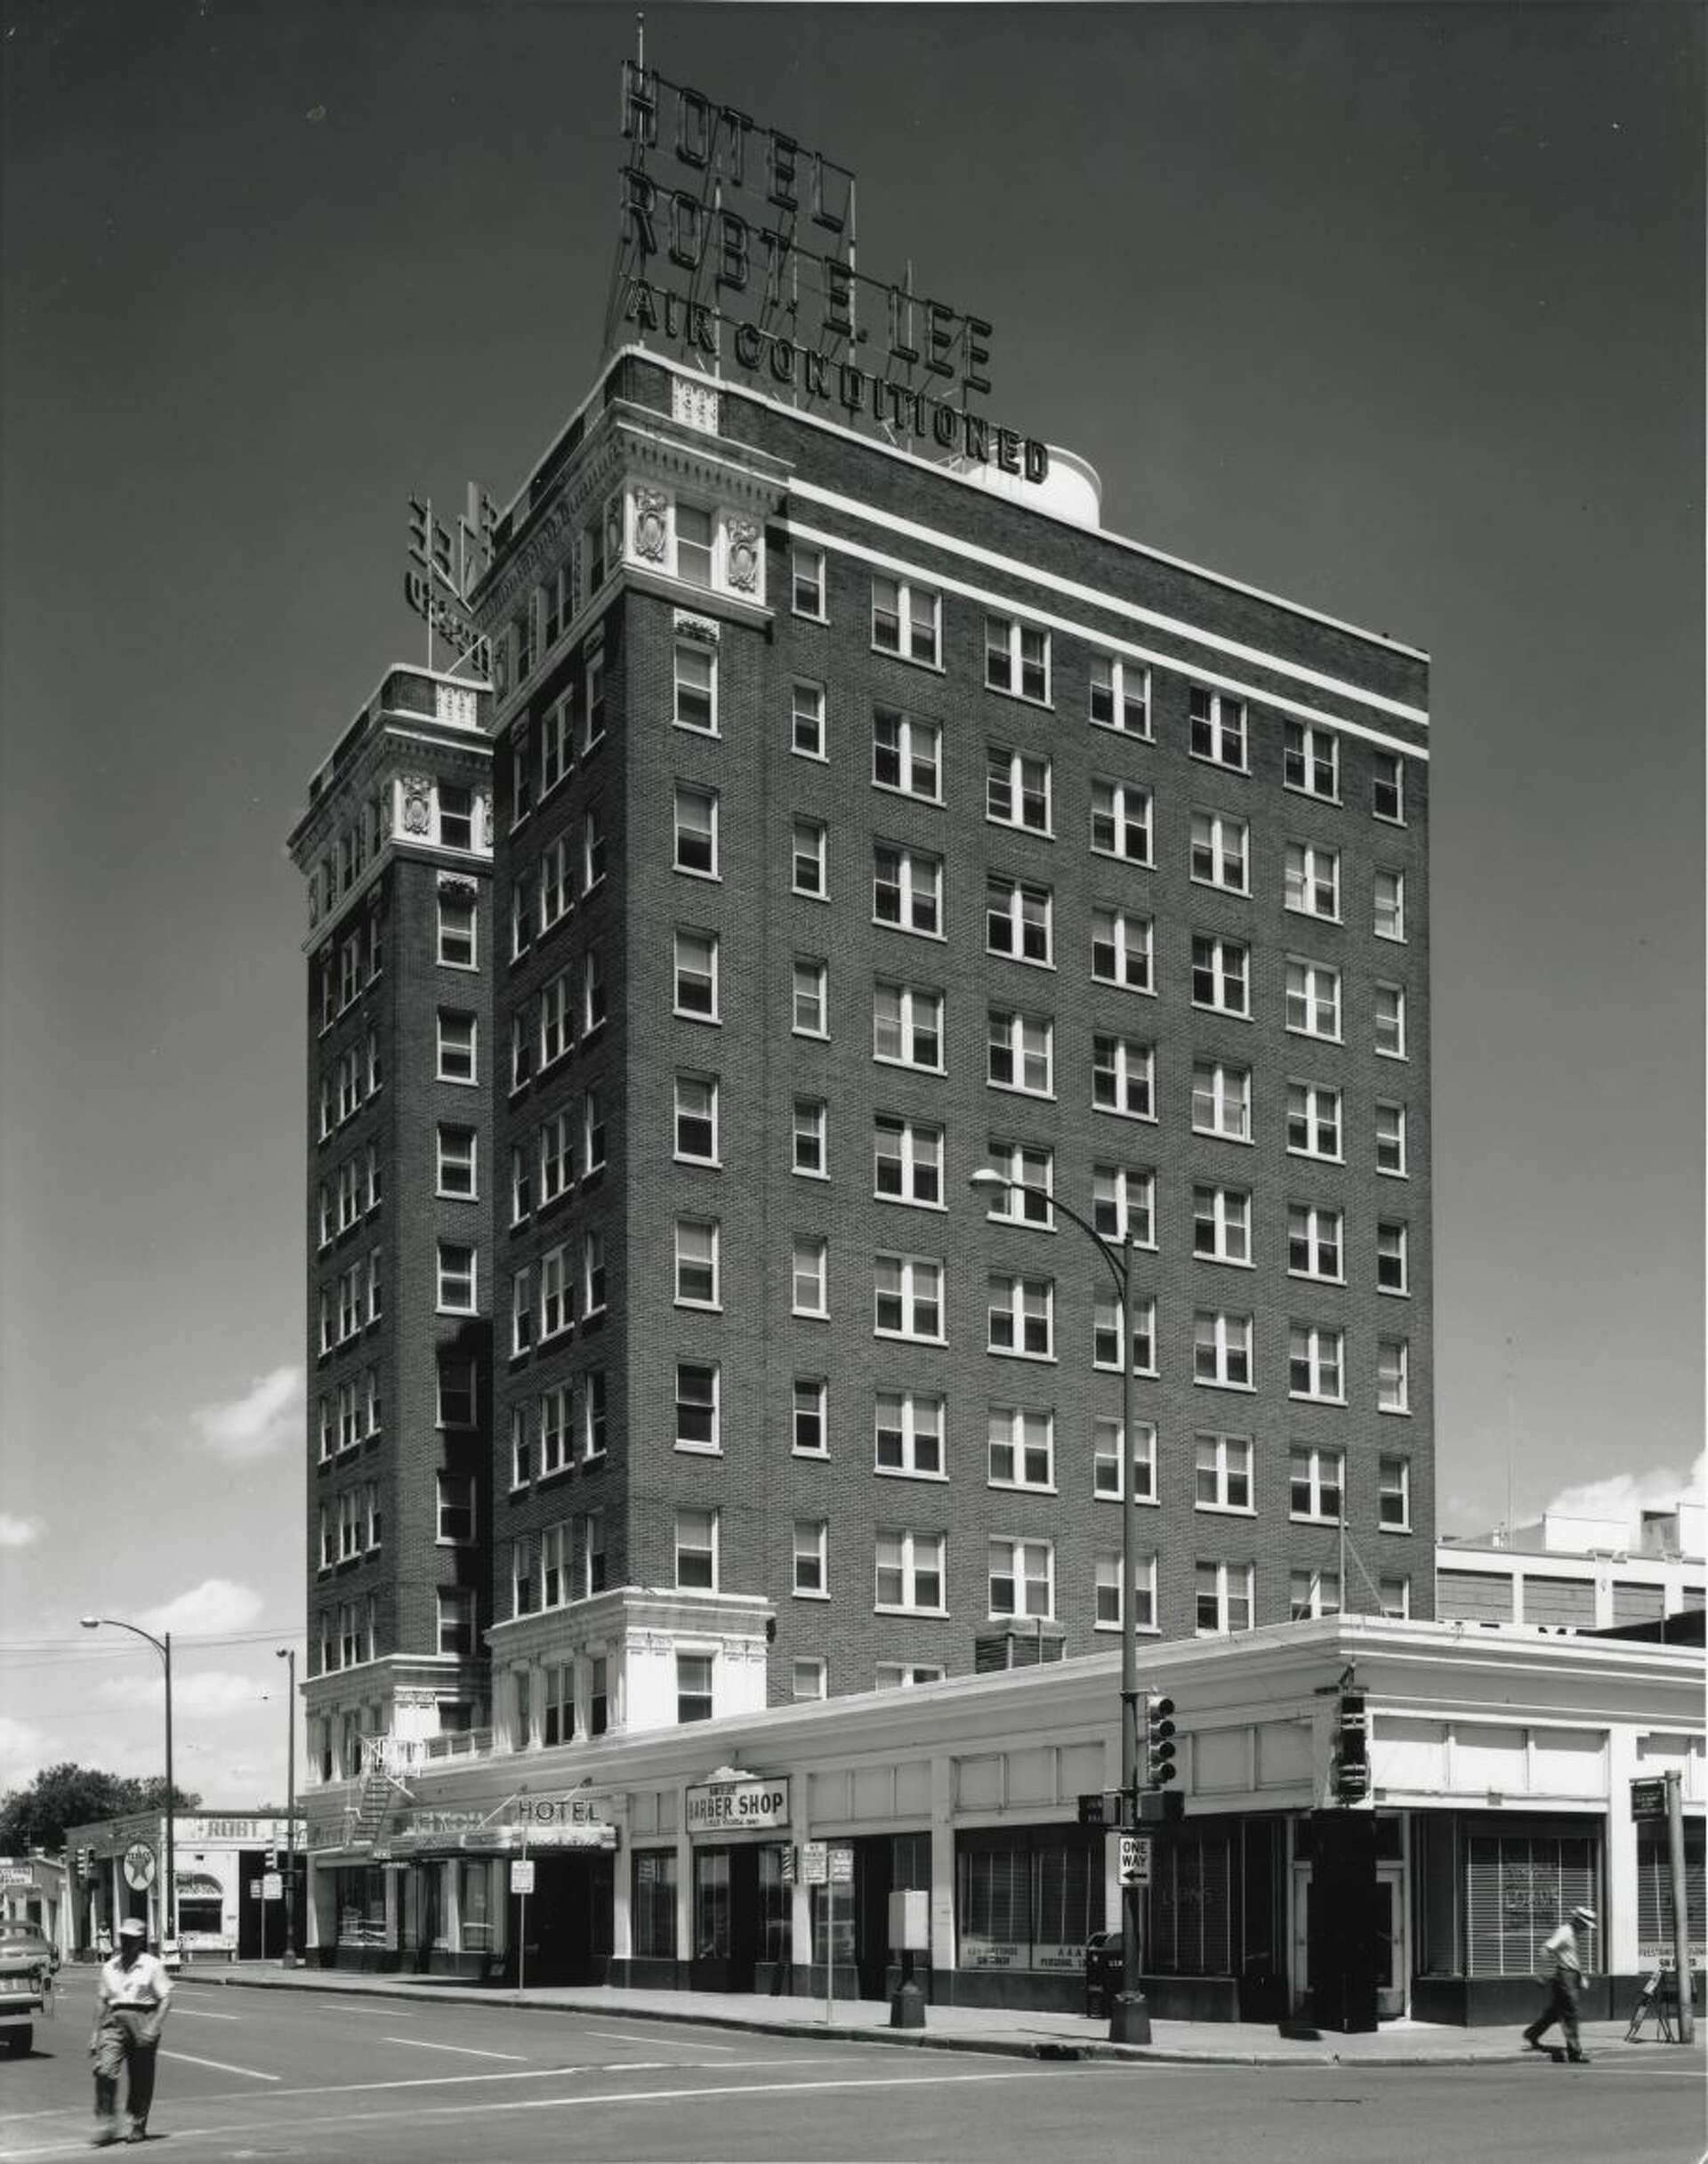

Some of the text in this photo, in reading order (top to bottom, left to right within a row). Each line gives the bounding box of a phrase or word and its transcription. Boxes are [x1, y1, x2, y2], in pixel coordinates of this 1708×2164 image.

[622, 60, 844, 234] HOTEL
[890, 285, 993, 395] LEE
[625, 278, 1050, 485] AIR CONDITIONED
[519, 1799, 600, 1822] HOTEL
[739, 1791, 784, 1815] SHOP
[207, 1821, 260, 1837] ROBT
[1122, 1840, 1148, 1854] ONE
[1122, 1854, 1148, 1868] WAY
